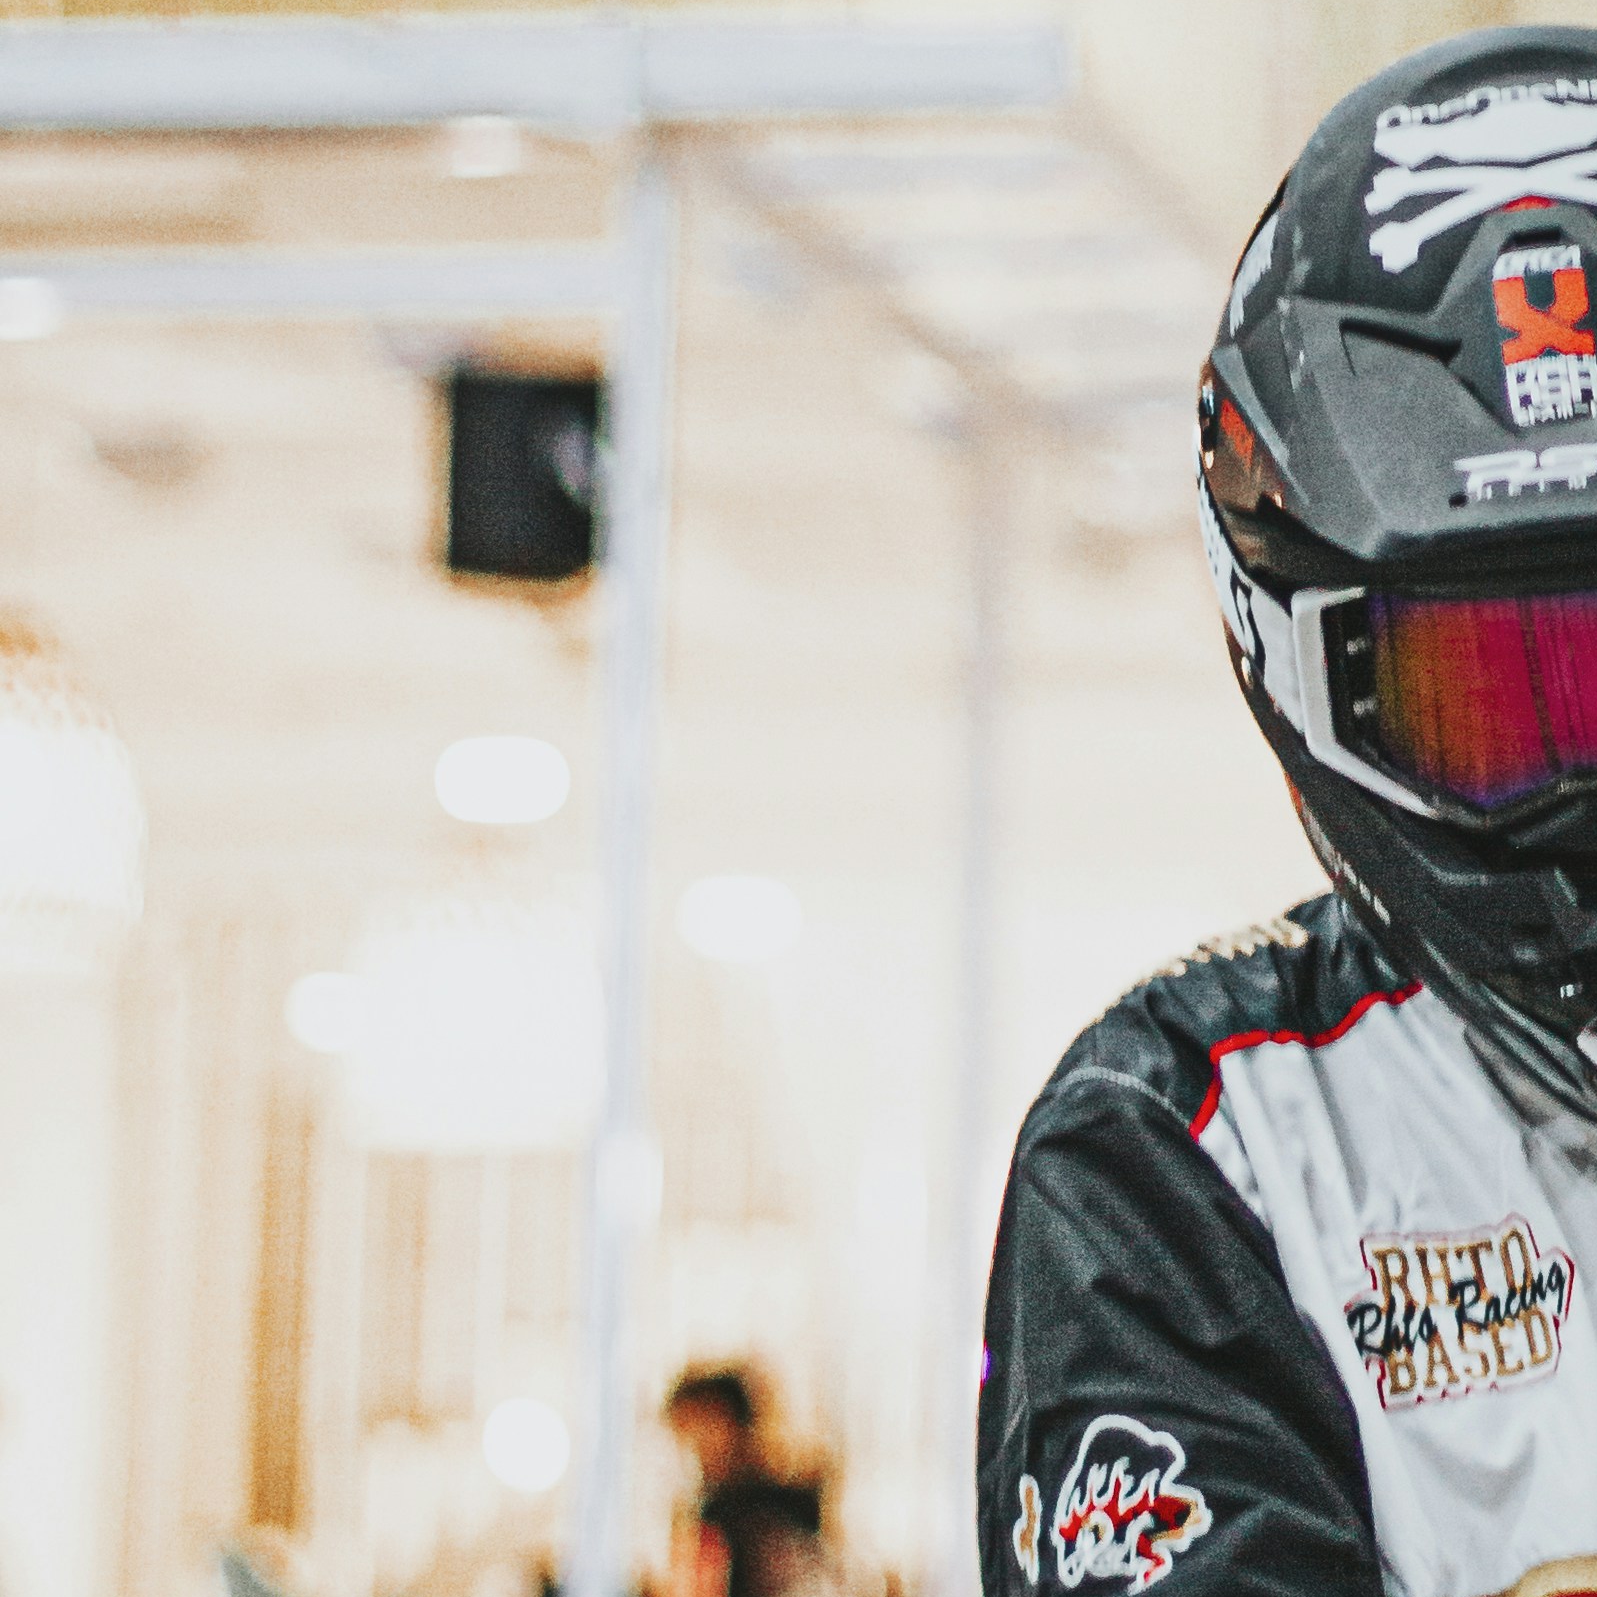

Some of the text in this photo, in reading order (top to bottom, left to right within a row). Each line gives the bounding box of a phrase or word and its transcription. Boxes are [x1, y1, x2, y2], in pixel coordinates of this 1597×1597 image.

[1372, 1227, 1534, 1312] RHTO
[1448, 1260, 1567, 1343] Racing
[1387, 1306, 1553, 1396] BASED
